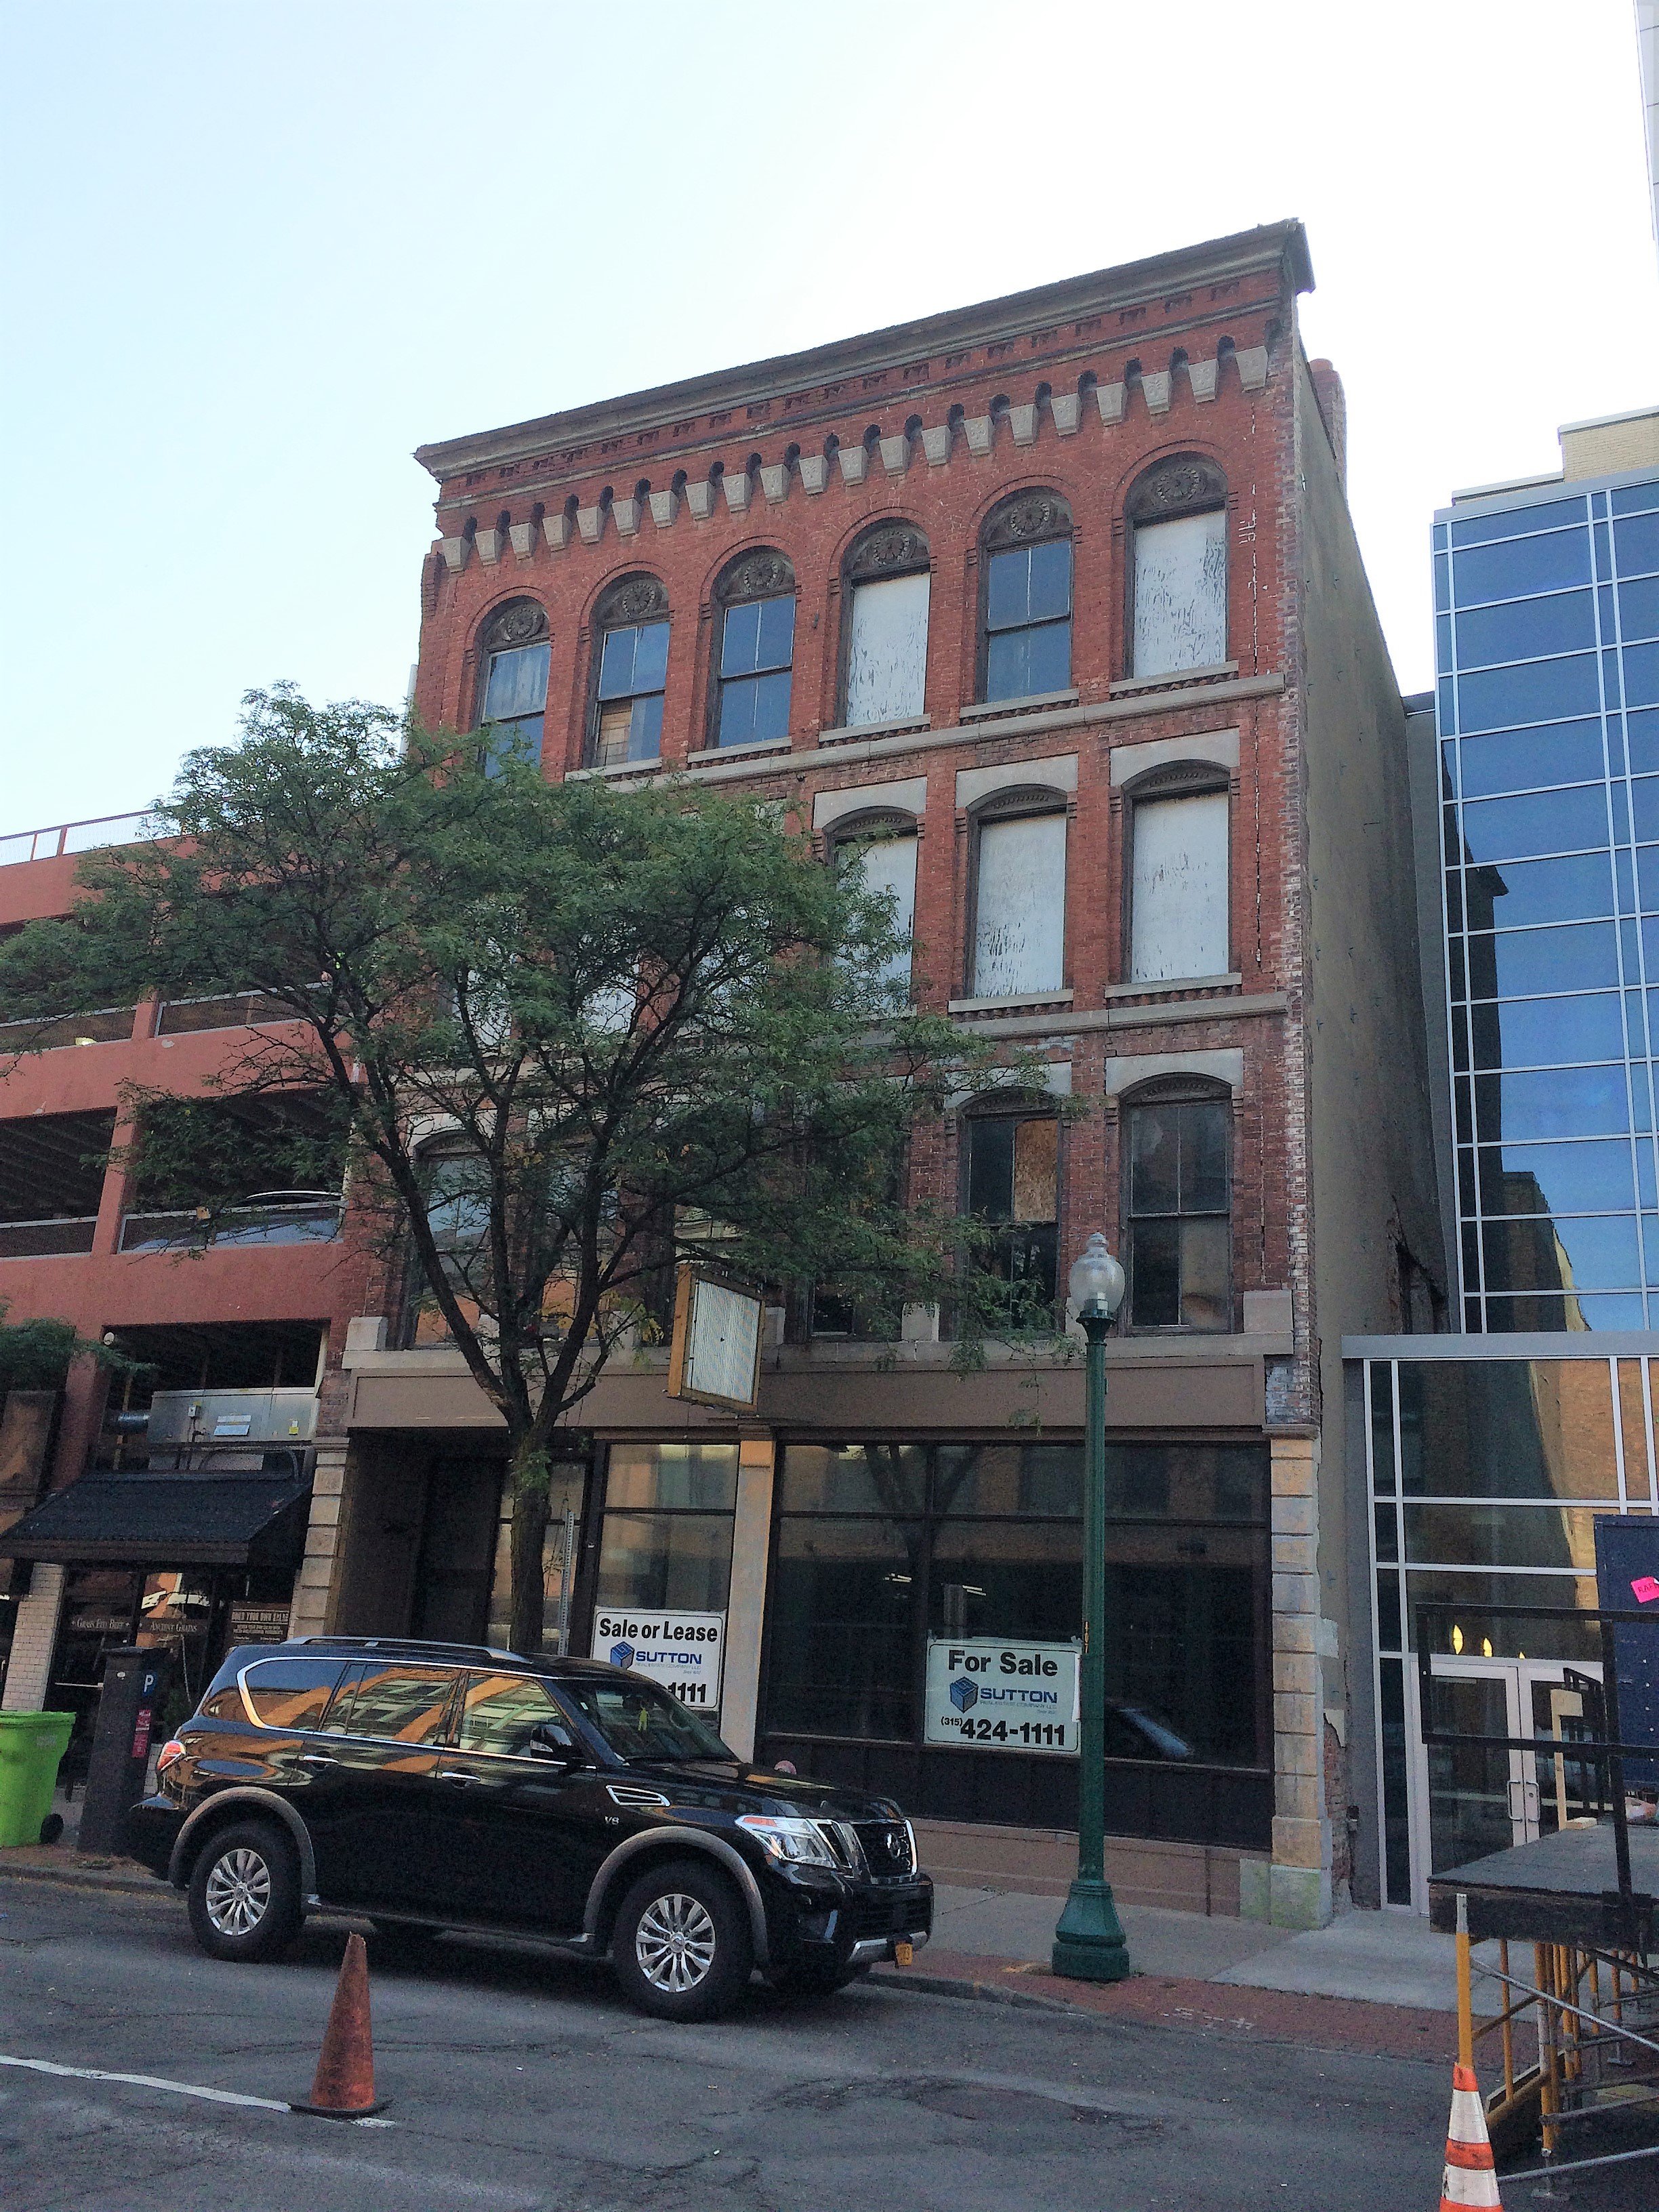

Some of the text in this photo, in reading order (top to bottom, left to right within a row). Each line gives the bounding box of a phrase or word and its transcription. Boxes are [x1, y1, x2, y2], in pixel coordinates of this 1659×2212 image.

[599, 1618, 718, 1642] Sale or Lease
[636, 1651, 702, 1664] SUTTON
[948, 1650, 1058, 1677] For Sale
[980, 1687, 1057, 1703] SUTTON
[941, 1716, 1065, 1746] (315) 424-1111
[605, 1816, 619, 1825] V8
